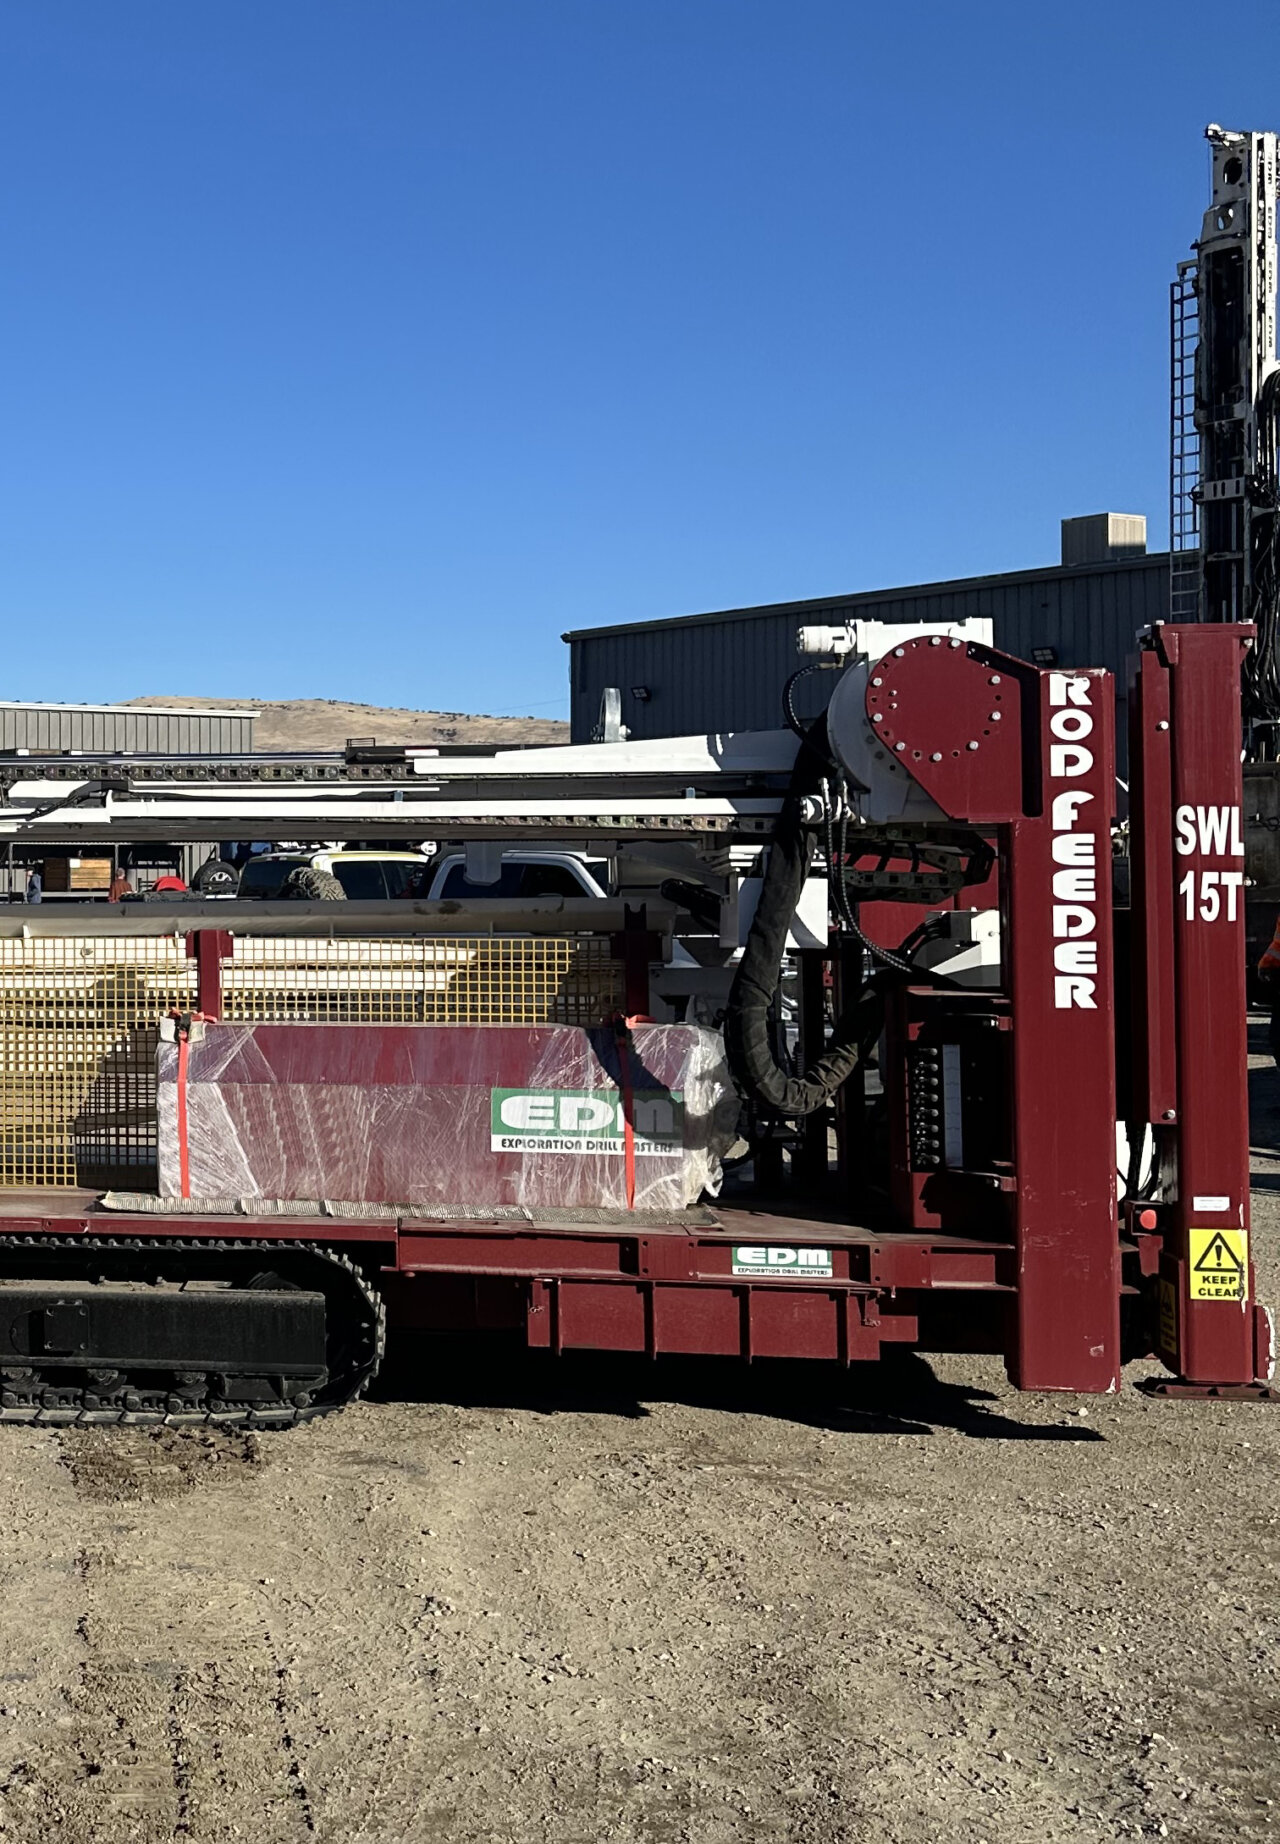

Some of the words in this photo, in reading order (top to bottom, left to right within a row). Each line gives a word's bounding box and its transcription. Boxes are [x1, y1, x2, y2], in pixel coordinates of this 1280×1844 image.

[1049, 674, 1093, 777] ROD
[1175, 805, 1246, 856] SWL
[1052, 790, 1098, 1009] FEEDER
[1179, 870, 1243, 922] 15T
[501, 1138, 582, 1150] EXPLORATION
[586, 1140, 618, 1152] DRILL
[737, 1247, 828, 1266] EDM
[1198, 1288, 1244, 1298] CLEAR
[1202, 1275, 1237, 1285] KEEP
